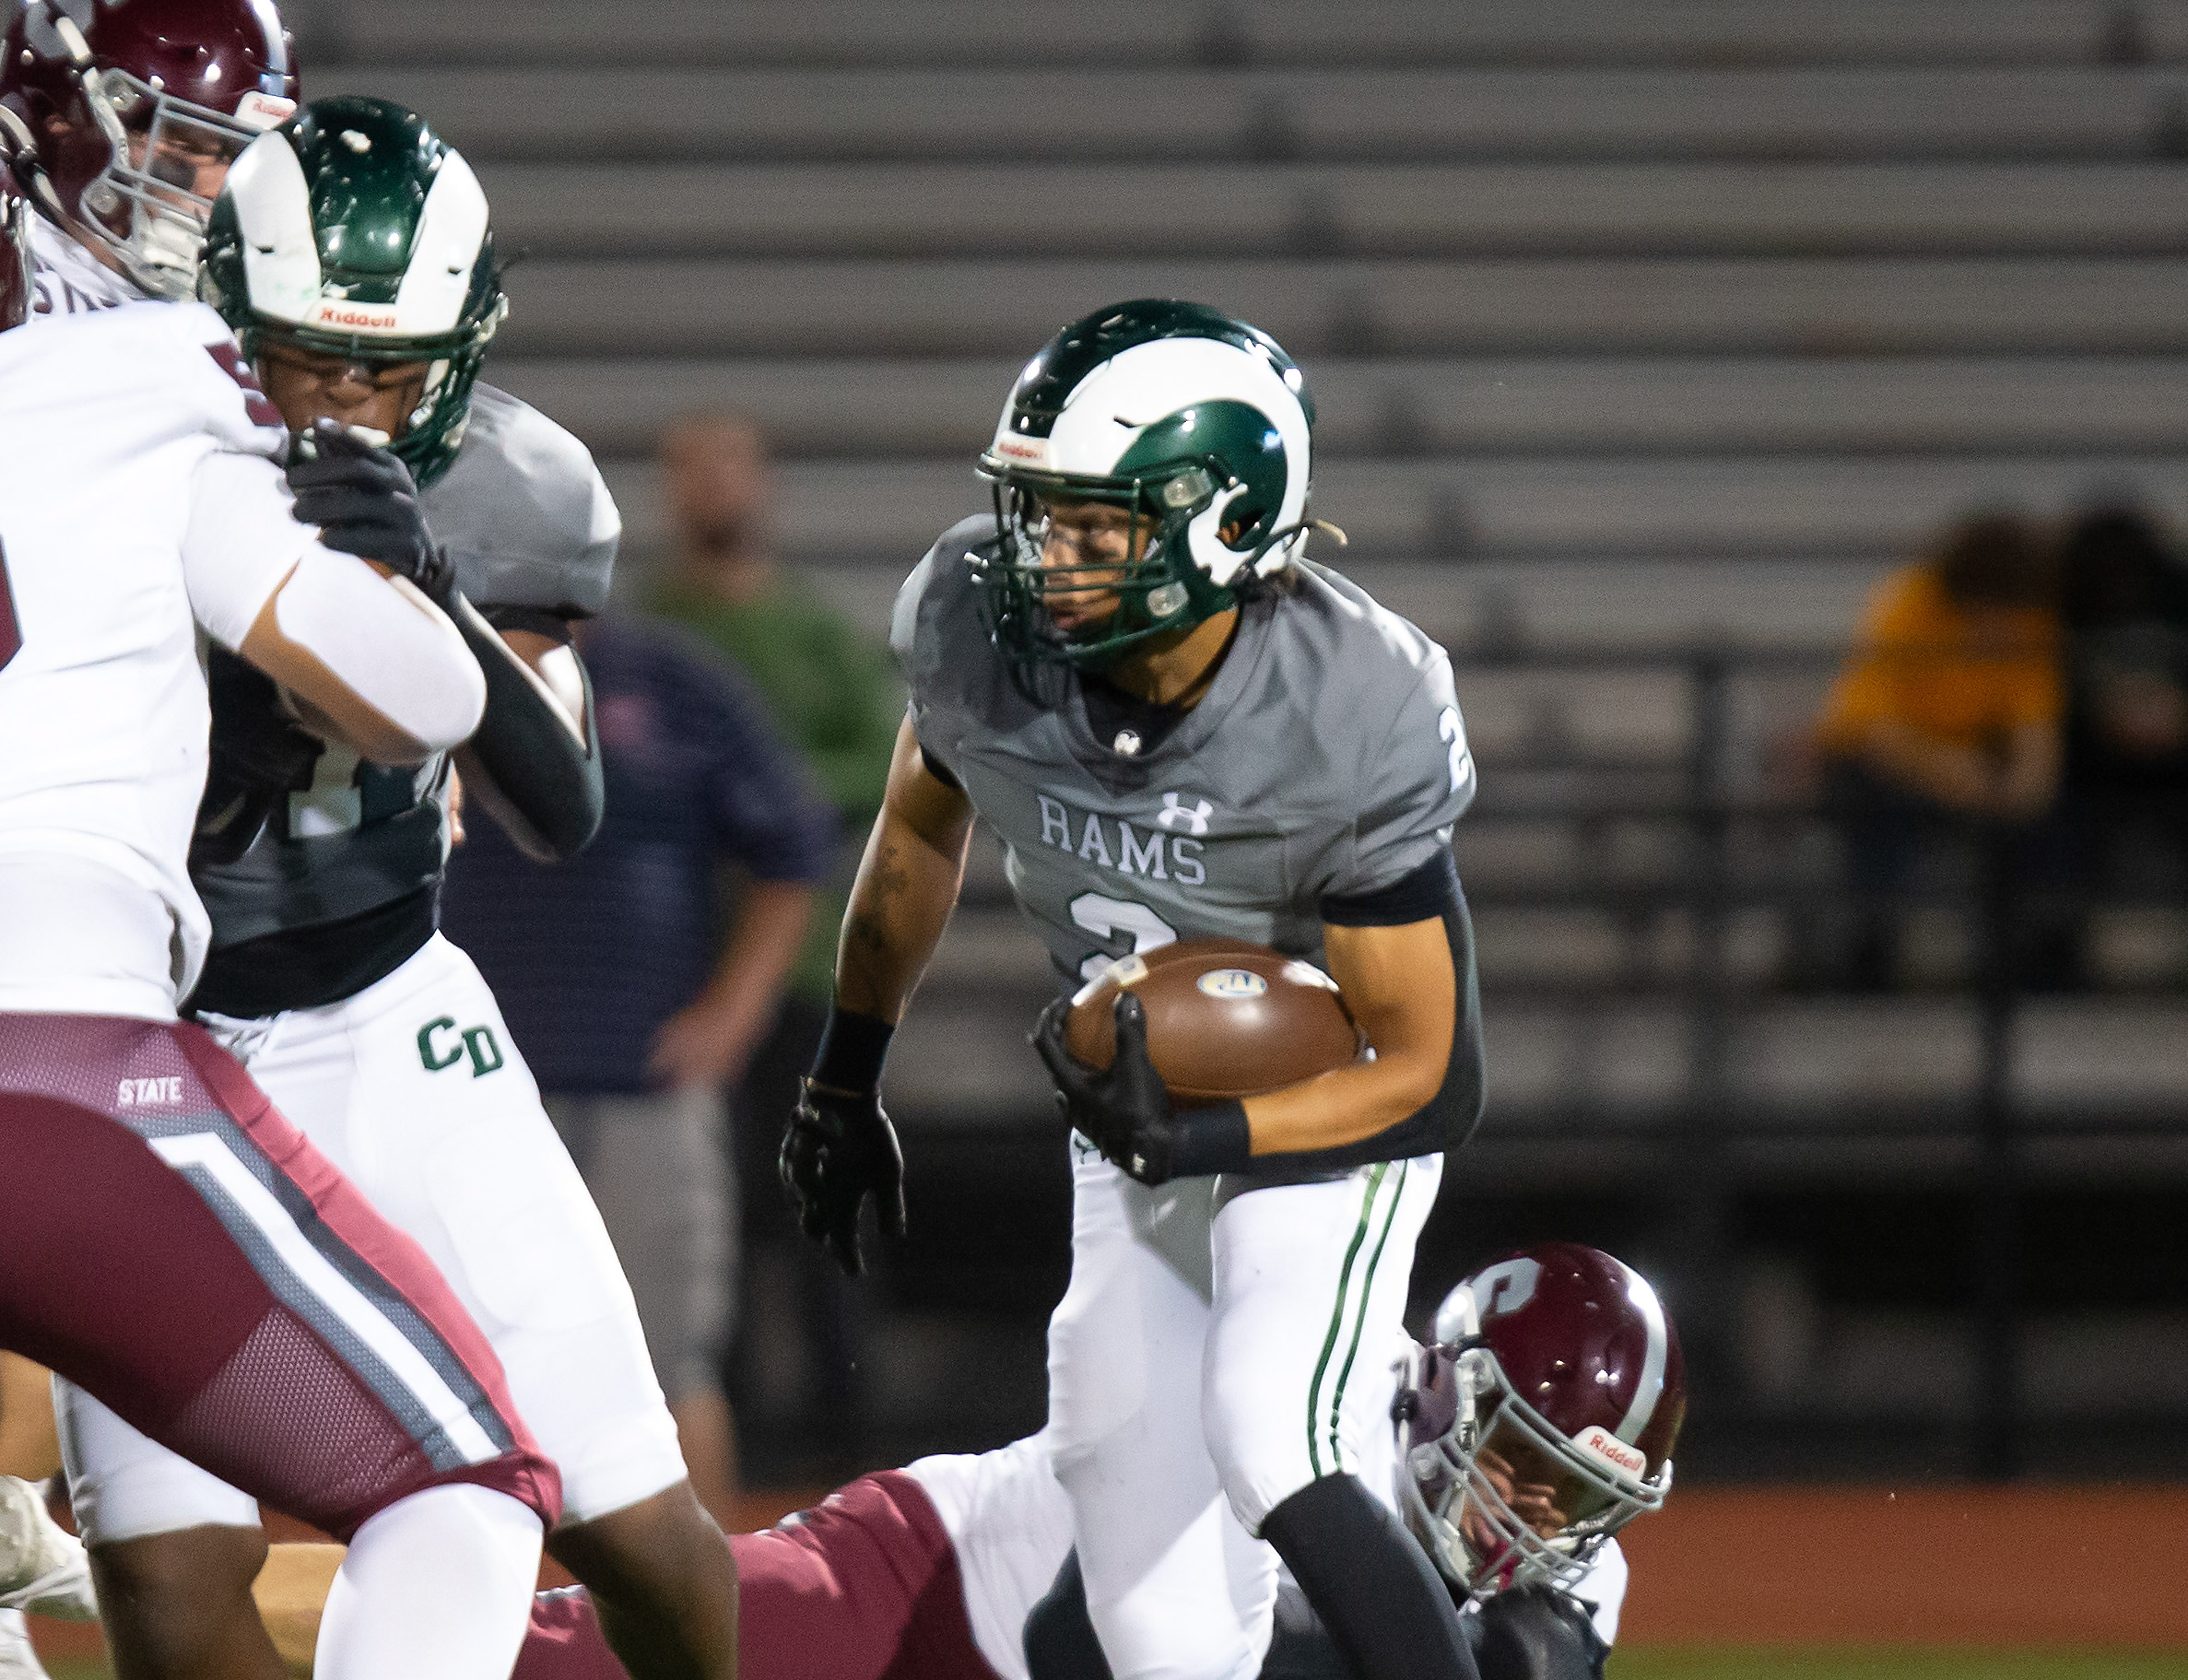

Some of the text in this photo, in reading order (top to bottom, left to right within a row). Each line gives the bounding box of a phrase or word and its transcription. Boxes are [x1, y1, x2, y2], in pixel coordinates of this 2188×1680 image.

[321, 307, 396, 328] Riddell
[1439, 706, 1469, 793] 2
[1038, 794, 1205, 885] RAMS
[417, 1015, 503, 1077] CD
[118, 1076, 183, 1108] STATE
[1589, 1434, 1644, 1471] Riddell
